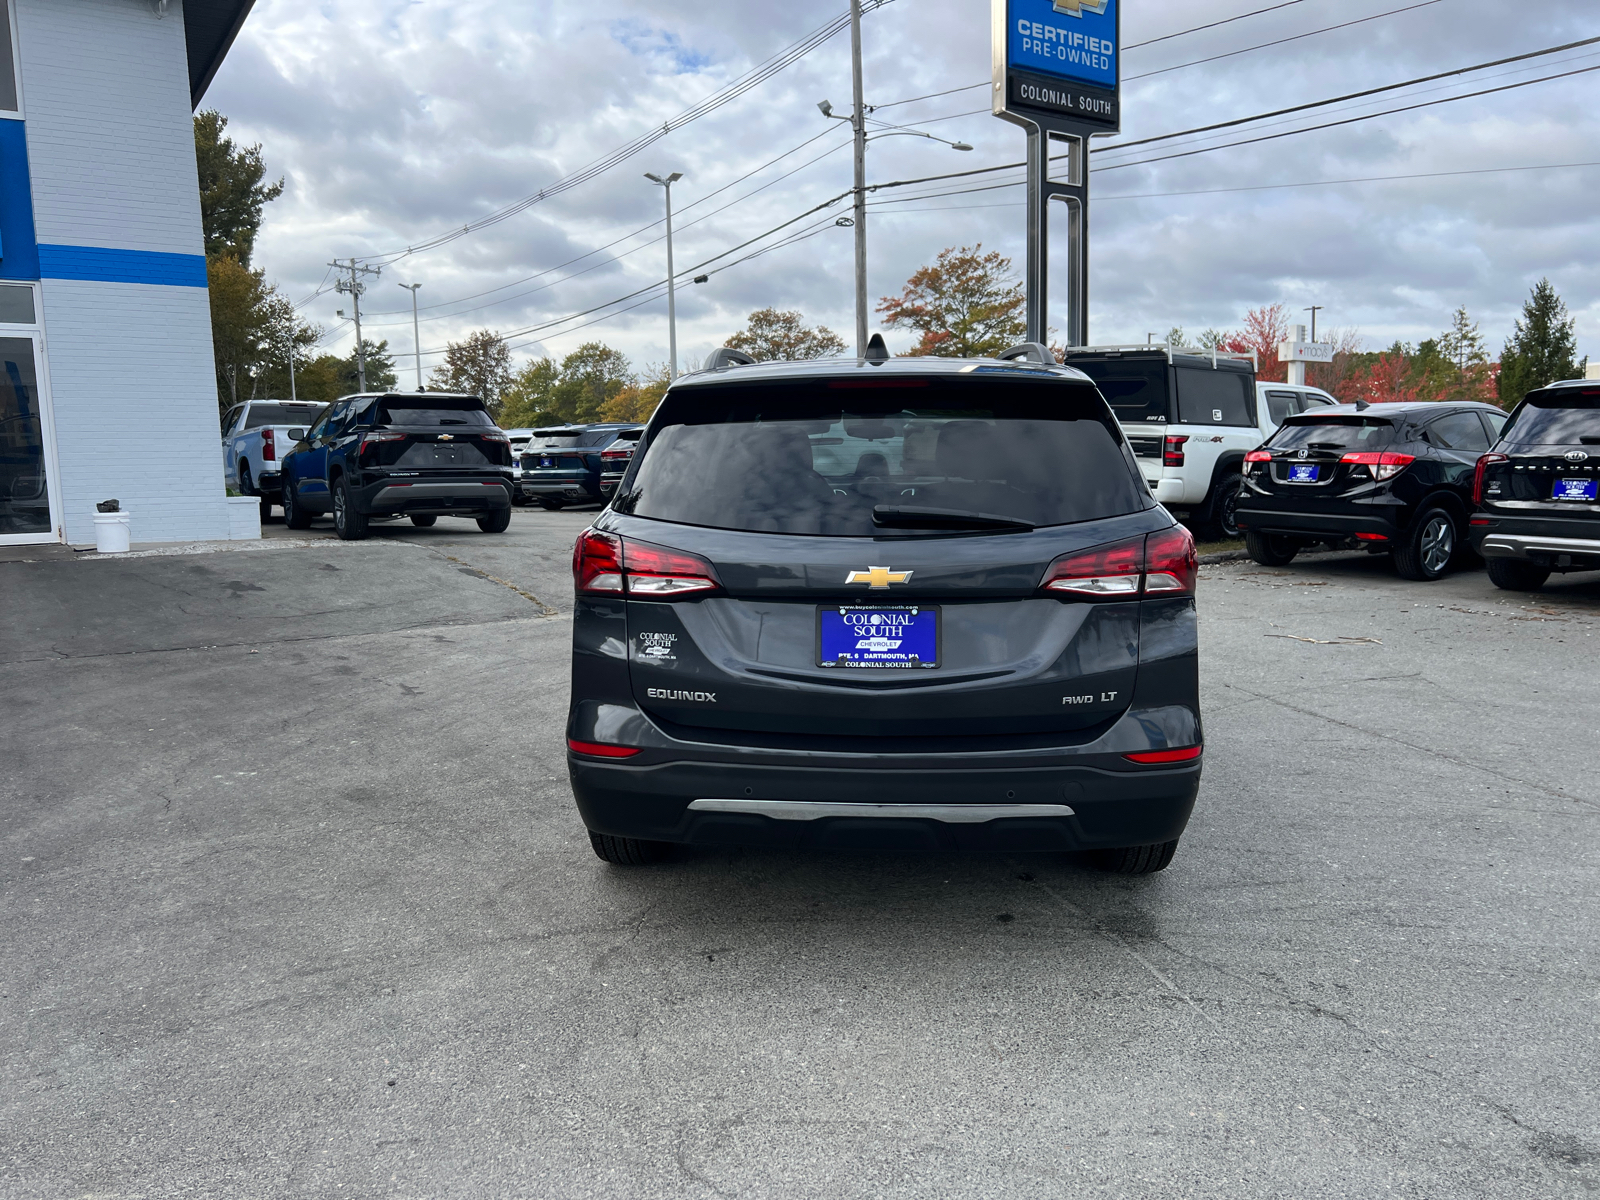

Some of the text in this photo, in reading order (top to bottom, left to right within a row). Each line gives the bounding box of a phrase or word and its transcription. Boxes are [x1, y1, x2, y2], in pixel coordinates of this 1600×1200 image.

[1018, 19, 1113, 56] CERTIFIED
[1022, 38, 1109, 70] PRE-OWNED
[1020, 84, 1111, 114] COLONIAL SOUTH
[1304, 346, 1328, 360] macy's
[843, 614, 914, 625] COLONIAL
[640, 632, 678, 641] COLONIAL
[854, 626, 903, 636] SOUTH
[647, 688, 717, 702] EQUINOX
[1062, 691, 1118, 705] AWD LT
